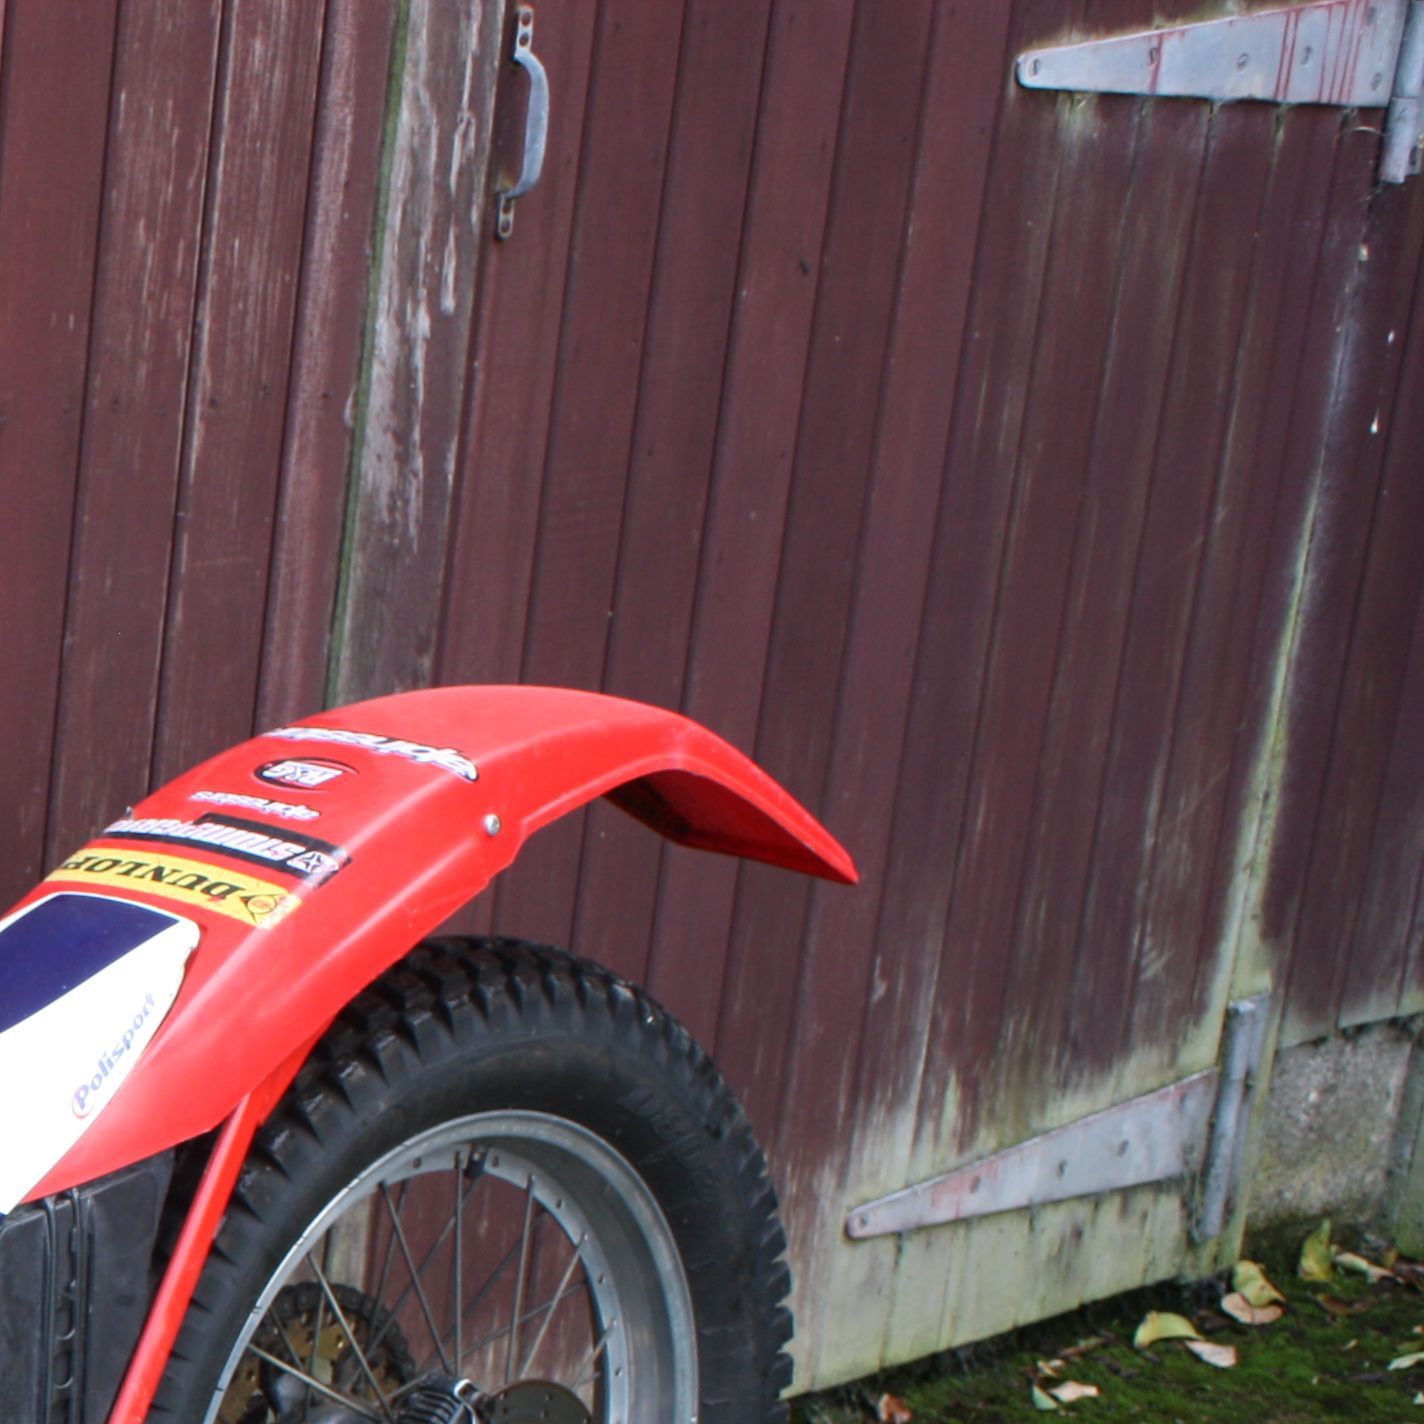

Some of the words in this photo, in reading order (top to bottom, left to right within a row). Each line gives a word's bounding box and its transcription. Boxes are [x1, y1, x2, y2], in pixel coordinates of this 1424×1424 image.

[260, 759, 344, 787] R&G
[262, 727, 479, 781] alpinesta
[62, 855, 247, 900] DUNLOP
[72, 992, 155, 1115] Polisport
